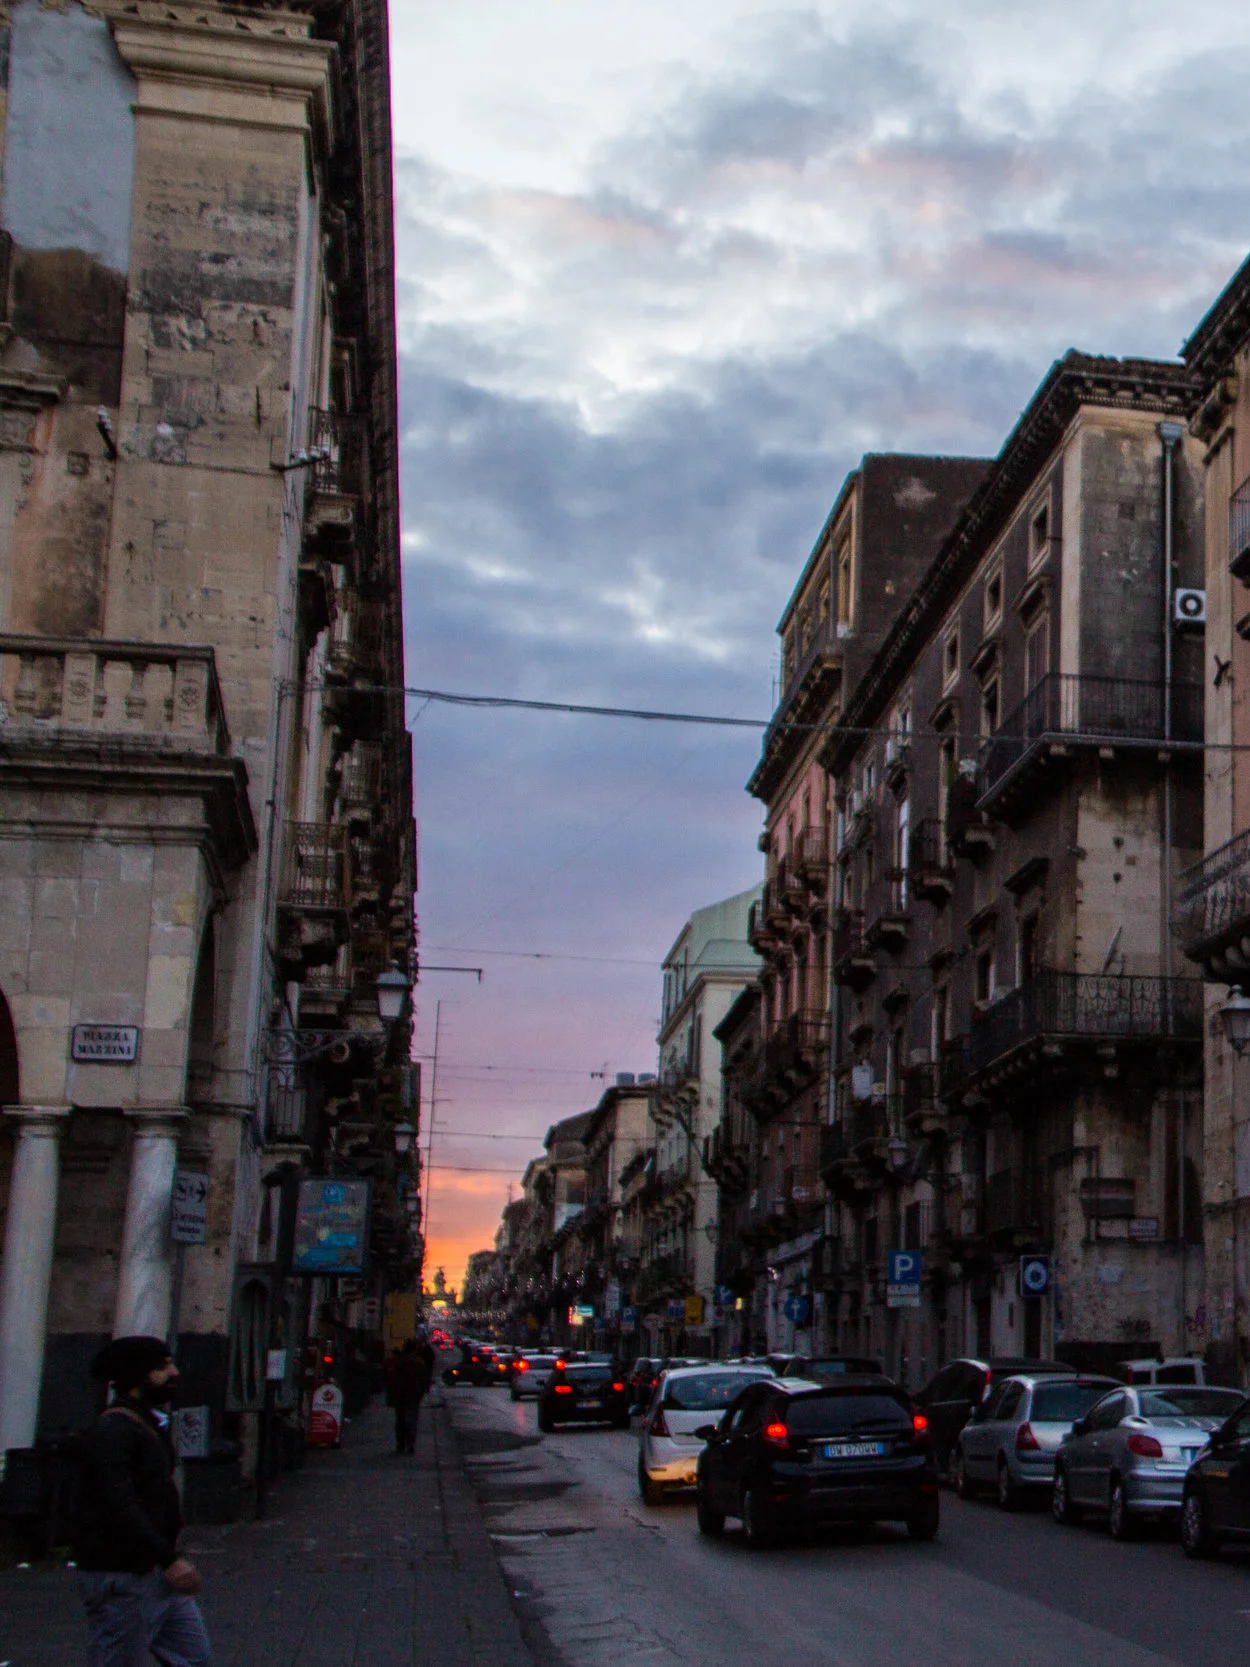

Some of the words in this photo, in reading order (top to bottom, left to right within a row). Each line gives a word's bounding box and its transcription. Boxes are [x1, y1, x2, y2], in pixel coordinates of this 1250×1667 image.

[83, 1031, 129, 1041] PIAZZA
[78, 1044, 131, 1055] MAZZINI
[895, 1254, 914, 1280] P
